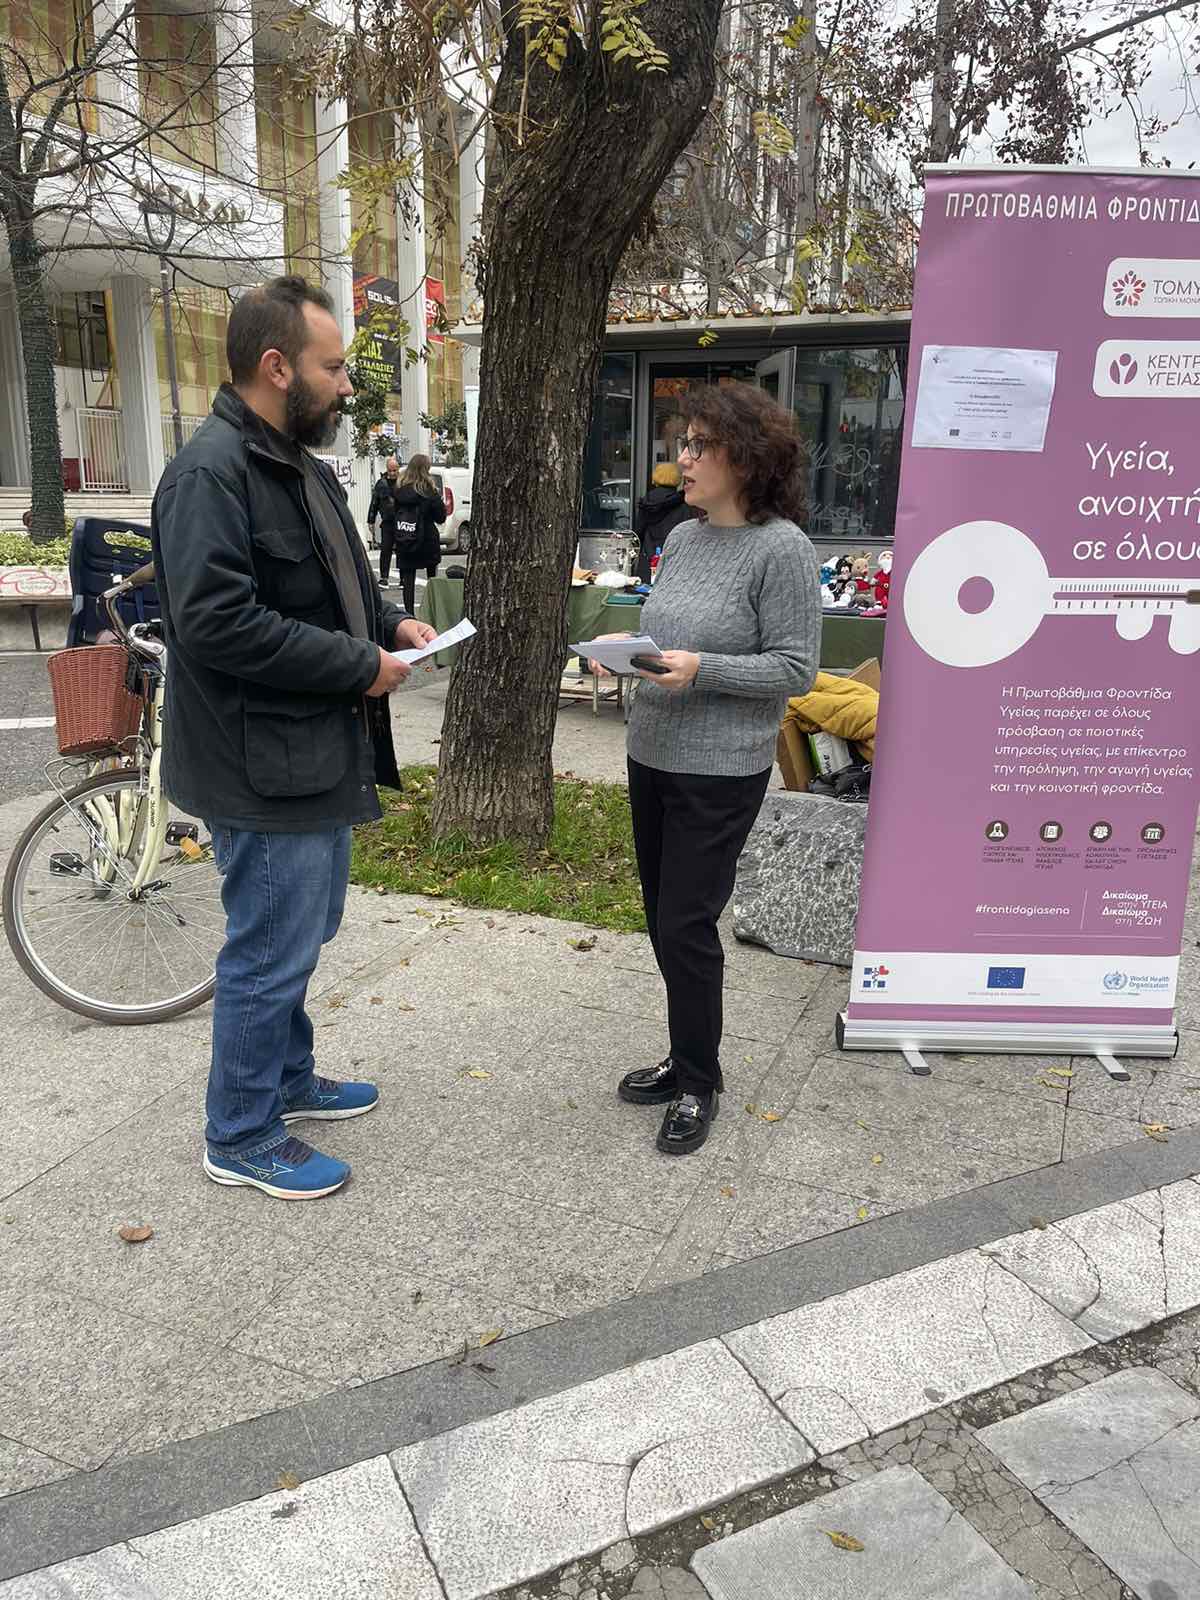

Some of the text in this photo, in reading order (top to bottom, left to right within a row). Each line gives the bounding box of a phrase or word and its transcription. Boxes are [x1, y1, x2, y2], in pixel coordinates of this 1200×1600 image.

[945, 193, 1200, 223] ΠΡΩΤΟΒΑΘΜΙΑ ΦΡΟΝΤΙΔ
[1147, 372, 1200, 386] ΥΓΕΙΑΣ
[1086, 441, 1175, 478] Υγεία,
[1078, 488, 1200, 524] ανοιχτή
[1073, 532, 1200, 560] σε όλου
[1001, 686, 1173, 700] Η Πρωτοβάθμια Φροντίδα
[1000, 705, 1152, 720] Υγείας παρέχει σε όλους
[997, 725, 1144, 739] πρόσβαση σε ποιοτικές
[994, 744, 1186, 760] υπηρεσίες υγείας, με επίκεντρο
[993, 763, 1193, 779] την πρόληψη, την αγωγή υγείας
[990, 783, 1009, 792] και
[1014, 783, 1036, 795] την
[1038, 782, 1098, 795] κοινοτική
[1102, 890, 1149, 901] Δικαίωμα
[1141, 900, 1168, 909] ΥΓΕΙΑ
[1102, 906, 1148, 918] Δικαίωμα
[1115, 917, 1162, 926] στη ΖΩΗ
[1128, 981, 1169, 989] Organization
